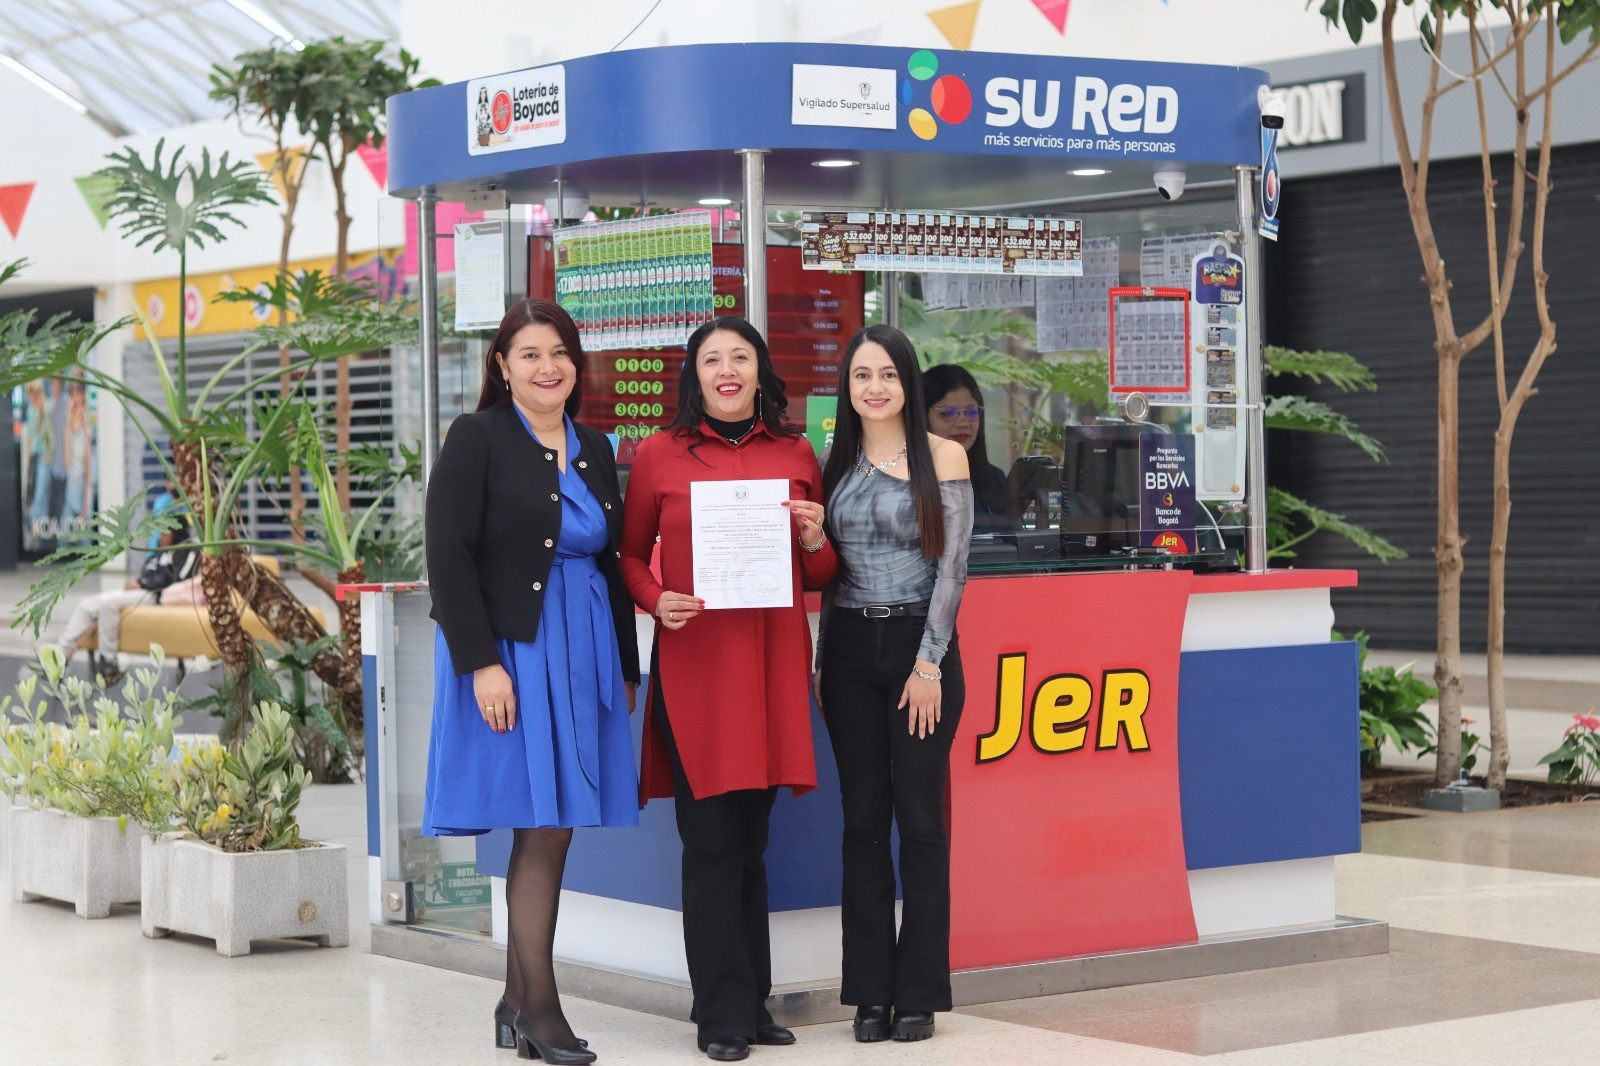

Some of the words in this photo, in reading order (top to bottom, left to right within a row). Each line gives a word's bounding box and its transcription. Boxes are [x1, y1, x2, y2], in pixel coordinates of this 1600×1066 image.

[513, 82, 547, 102] Lotería
[548, 82, 559, 96] de
[513, 95, 560, 123] Boyacá
[799, 97, 838, 109] Vigilado
[840, 99, 890, 111] Supersalud
[984, 76, 1061, 129] SU
[1276, 80, 1346, 147] ON
[984, 132, 1011, 146] más
[1013, 135, 1064, 148] servicios
[1067, 139, 1093, 152] para
[1096, 138, 1121, 151] más
[1124, 141, 1176, 154] personas
[712, 265, 741, 276] OTERÍA
[1157, 447, 1178, 455] Pregunta
[1145, 470, 1190, 490] BBVA
[1155, 507, 1174, 516] Banco
[1174, 507, 1182, 516] de
[1158, 516, 1179, 526] Bogotá
[1160, 535, 1178, 547] JeR
[975, 652, 1151, 765] JeR
[456, 868, 475, 877] RUTA
